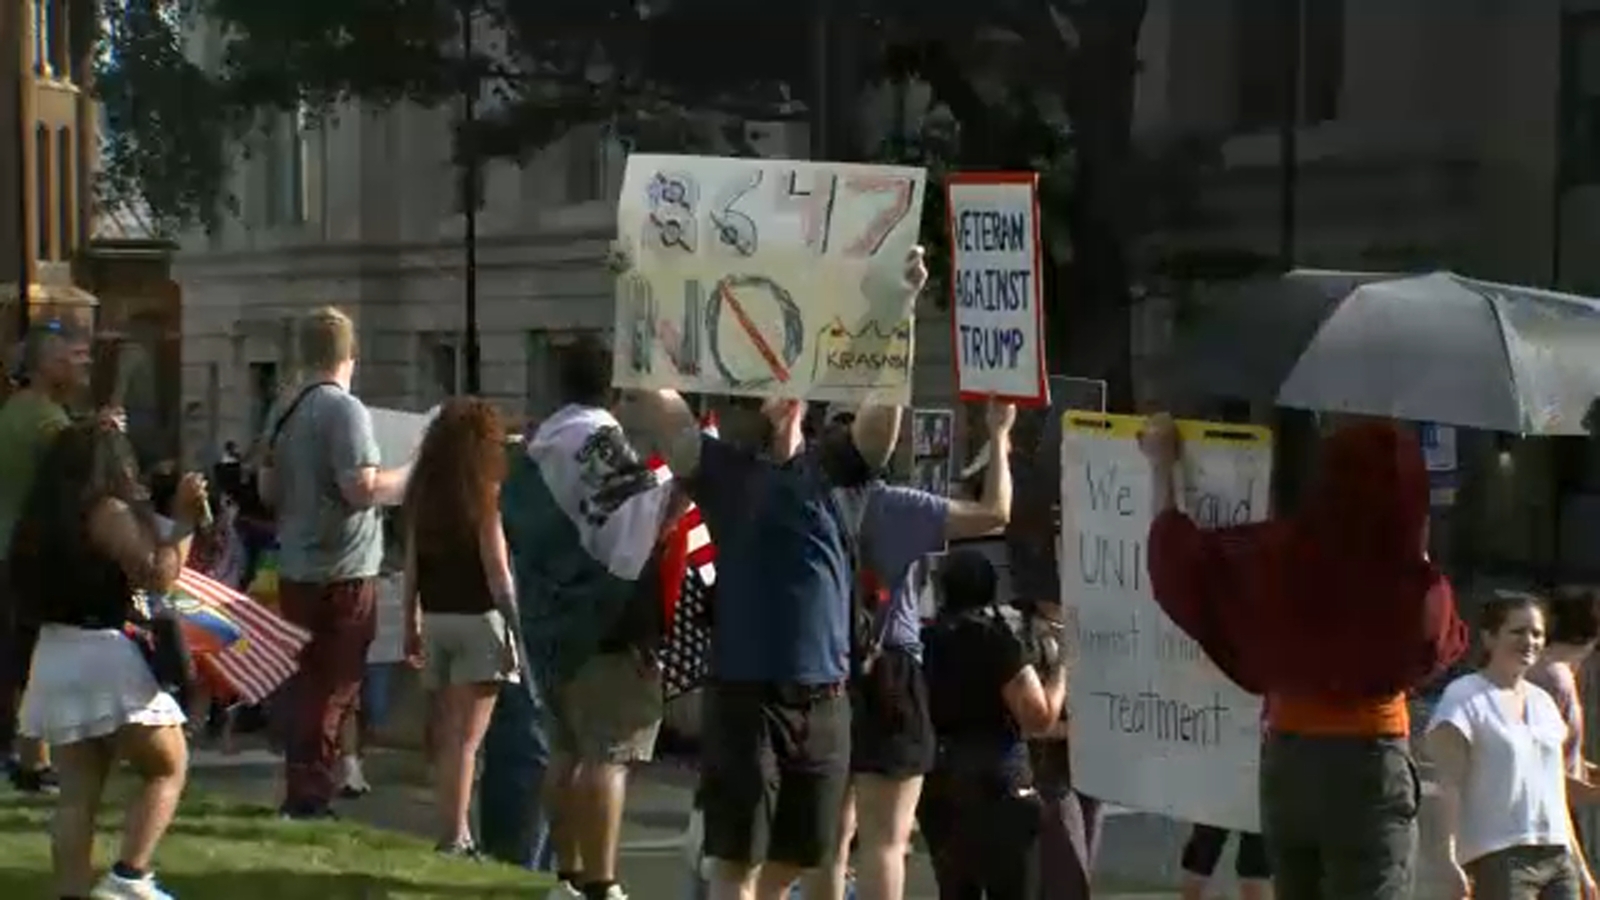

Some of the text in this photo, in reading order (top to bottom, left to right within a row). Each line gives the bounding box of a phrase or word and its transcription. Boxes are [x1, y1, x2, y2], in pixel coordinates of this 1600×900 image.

[954, 210, 1025, 251] VETERAN
[956, 269, 1031, 312] AGAINST
[960, 325, 1024, 369] TRUMP
[1086, 460, 1135, 516] We
[1080, 531, 1140, 591] UNI
